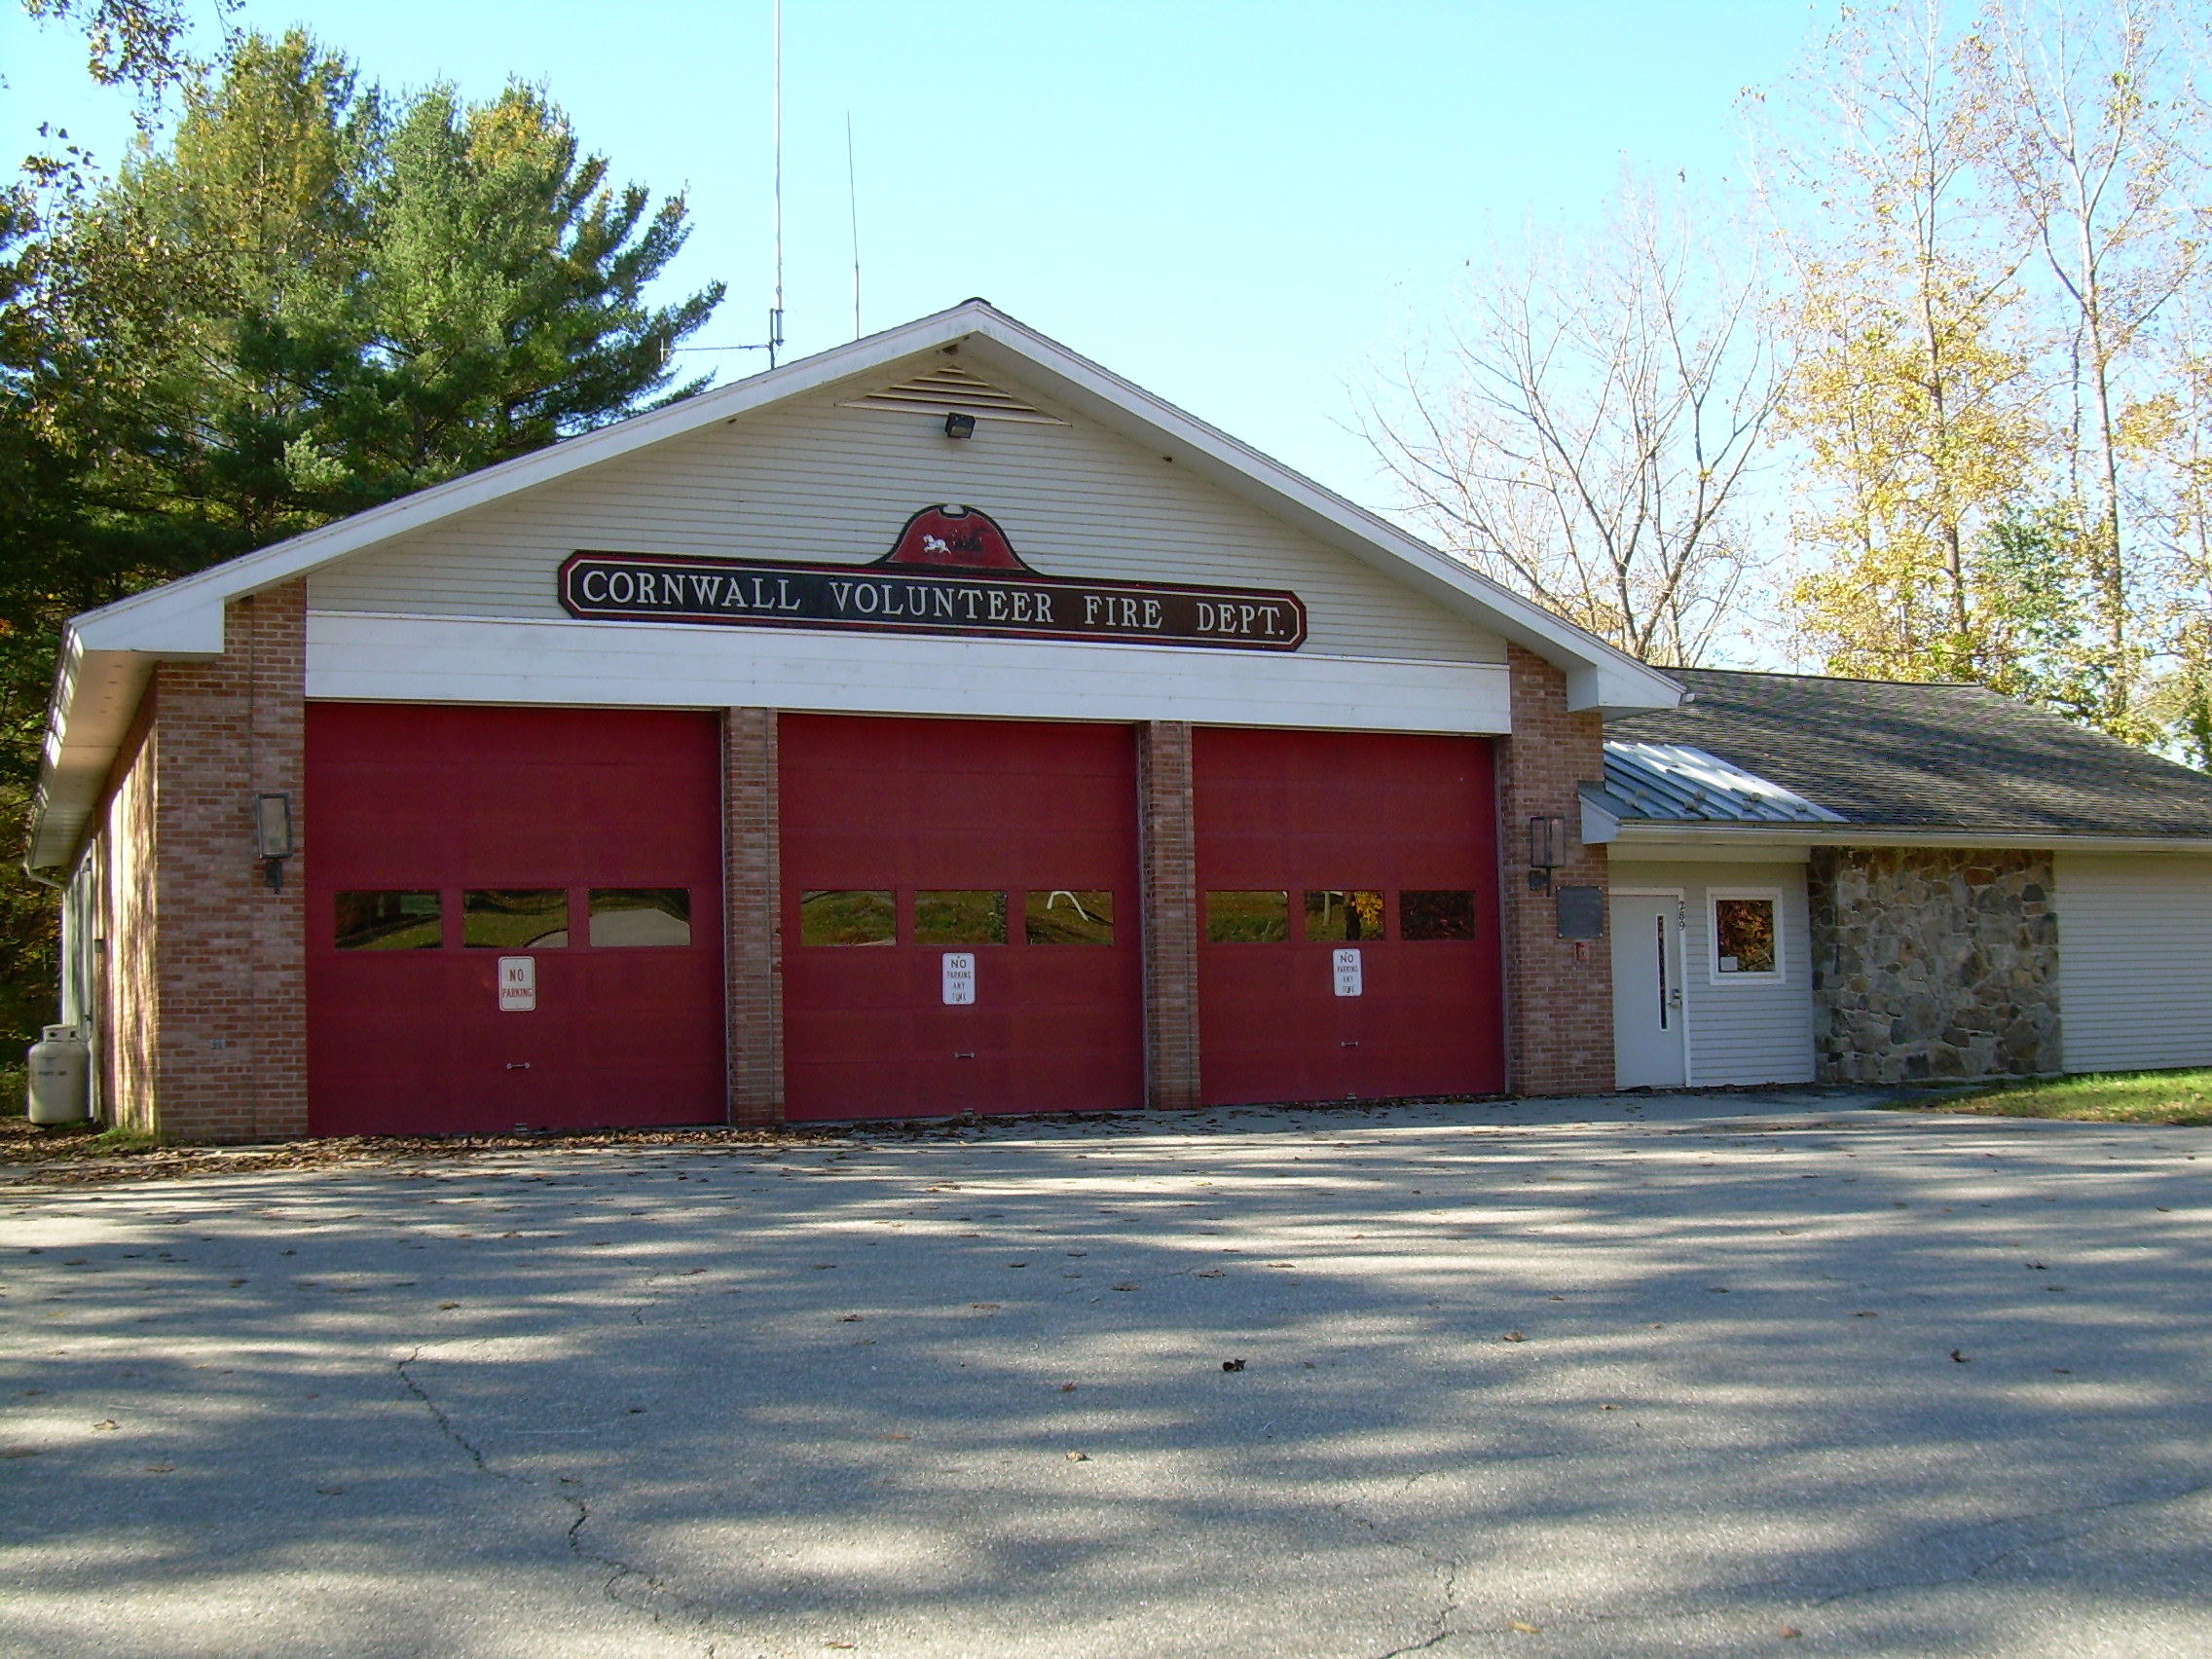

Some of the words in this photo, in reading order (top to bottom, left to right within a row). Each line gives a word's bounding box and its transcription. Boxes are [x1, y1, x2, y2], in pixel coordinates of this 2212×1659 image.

[582, 569, 801, 611] CORNWALL
[829, 578, 1054, 624] VOLUNTEER
[1084, 595, 1163, 629] FIRE
[1196, 602, 1286, 636] DEPT.
[1340, 954, 1354, 963] NO
[950, 959, 967, 969] NO
[509, 968, 524, 981] NO
[501, 987, 533, 997] PARKING
